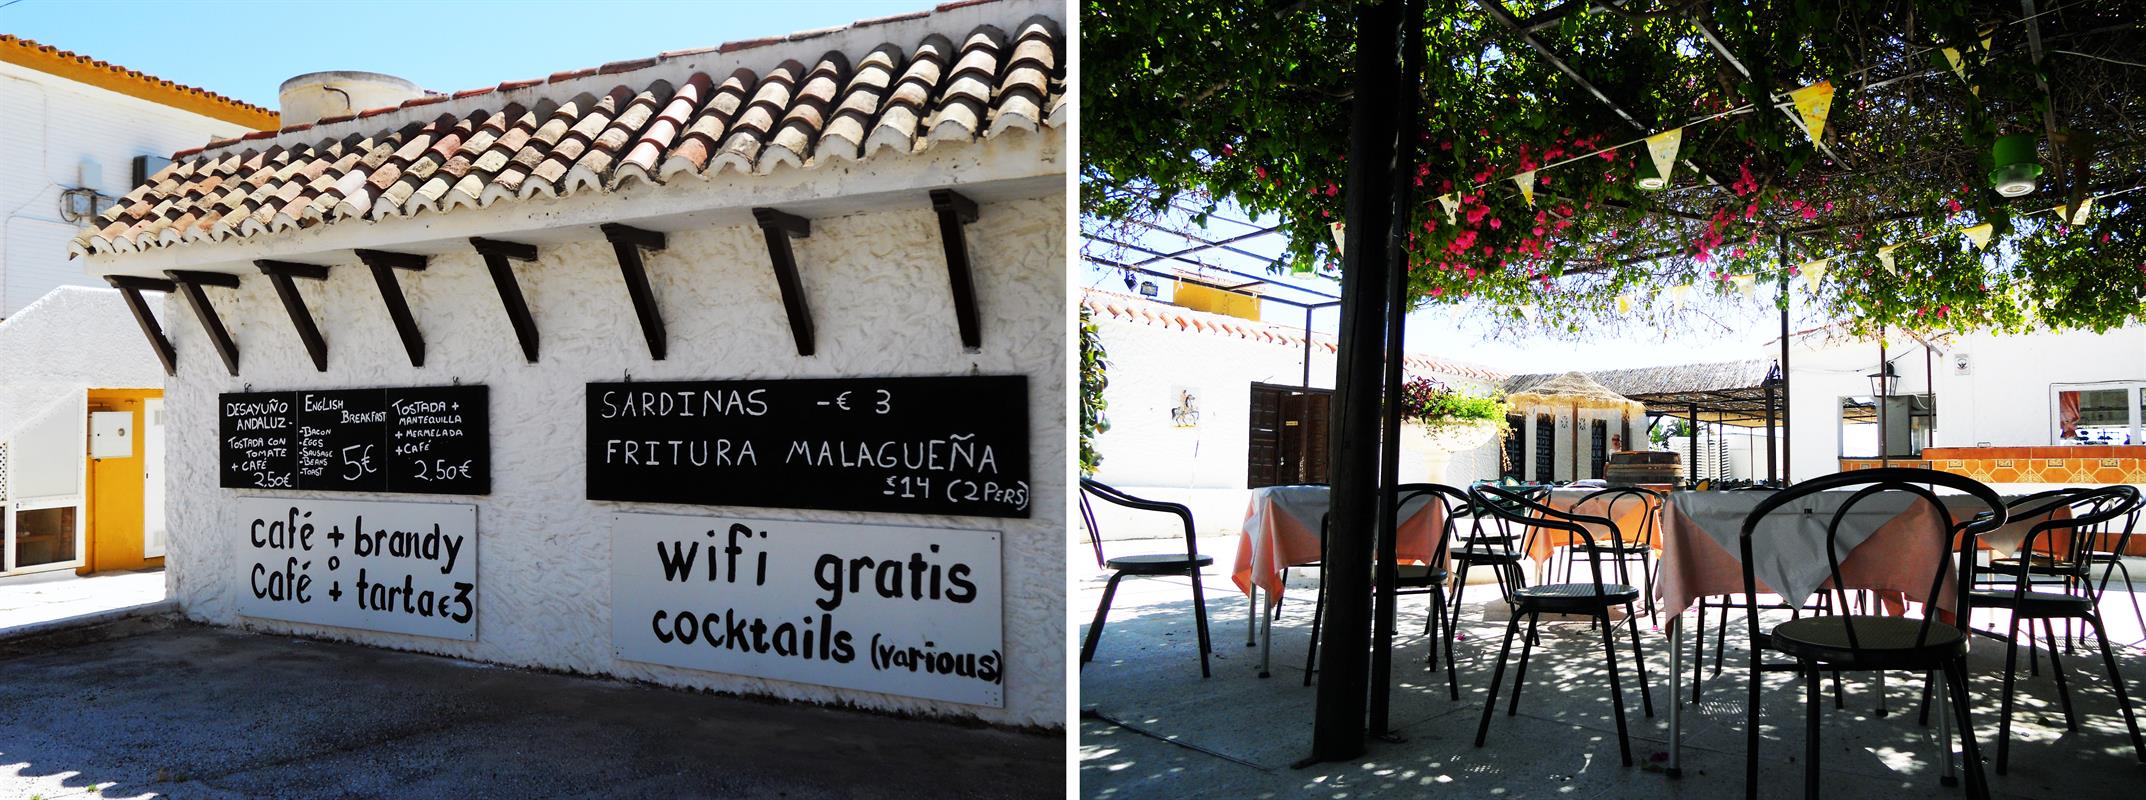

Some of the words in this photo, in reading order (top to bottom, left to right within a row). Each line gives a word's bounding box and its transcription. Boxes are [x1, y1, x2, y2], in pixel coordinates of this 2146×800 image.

[226, 399, 288, 417] DESAYUÑO
[305, 394, 344, 412] ENGLISH
[391, 398, 446, 416] TOSTADA
[601, 388, 768, 419] SARDINAS
[875, 389, 892, 415] 3
[340, 410, 386, 424] BREAKFAST
[398, 414, 462, 426] MANTEQUILLA
[405, 428, 464, 438] MERMELADA
[227, 436, 264, 449] TOSTADA
[268, 438, 286, 446] CON
[245, 448, 287, 458] TOMATE
[606, 439, 758, 467] FRITURA
[785, 433, 999, 475] MALAGUEÑA
[241, 457, 267, 471] CAFÉ
[342, 444, 377, 481] 5€
[251, 506, 315, 551] café
[327, 525, 345, 548] +
[354, 515, 464, 574] brandy
[657, 523, 768, 586] wifi
[814, 544, 977, 611] gratis
[652, 607, 856, 664] cocktails
[870, 632, 1003, 685] (various)
